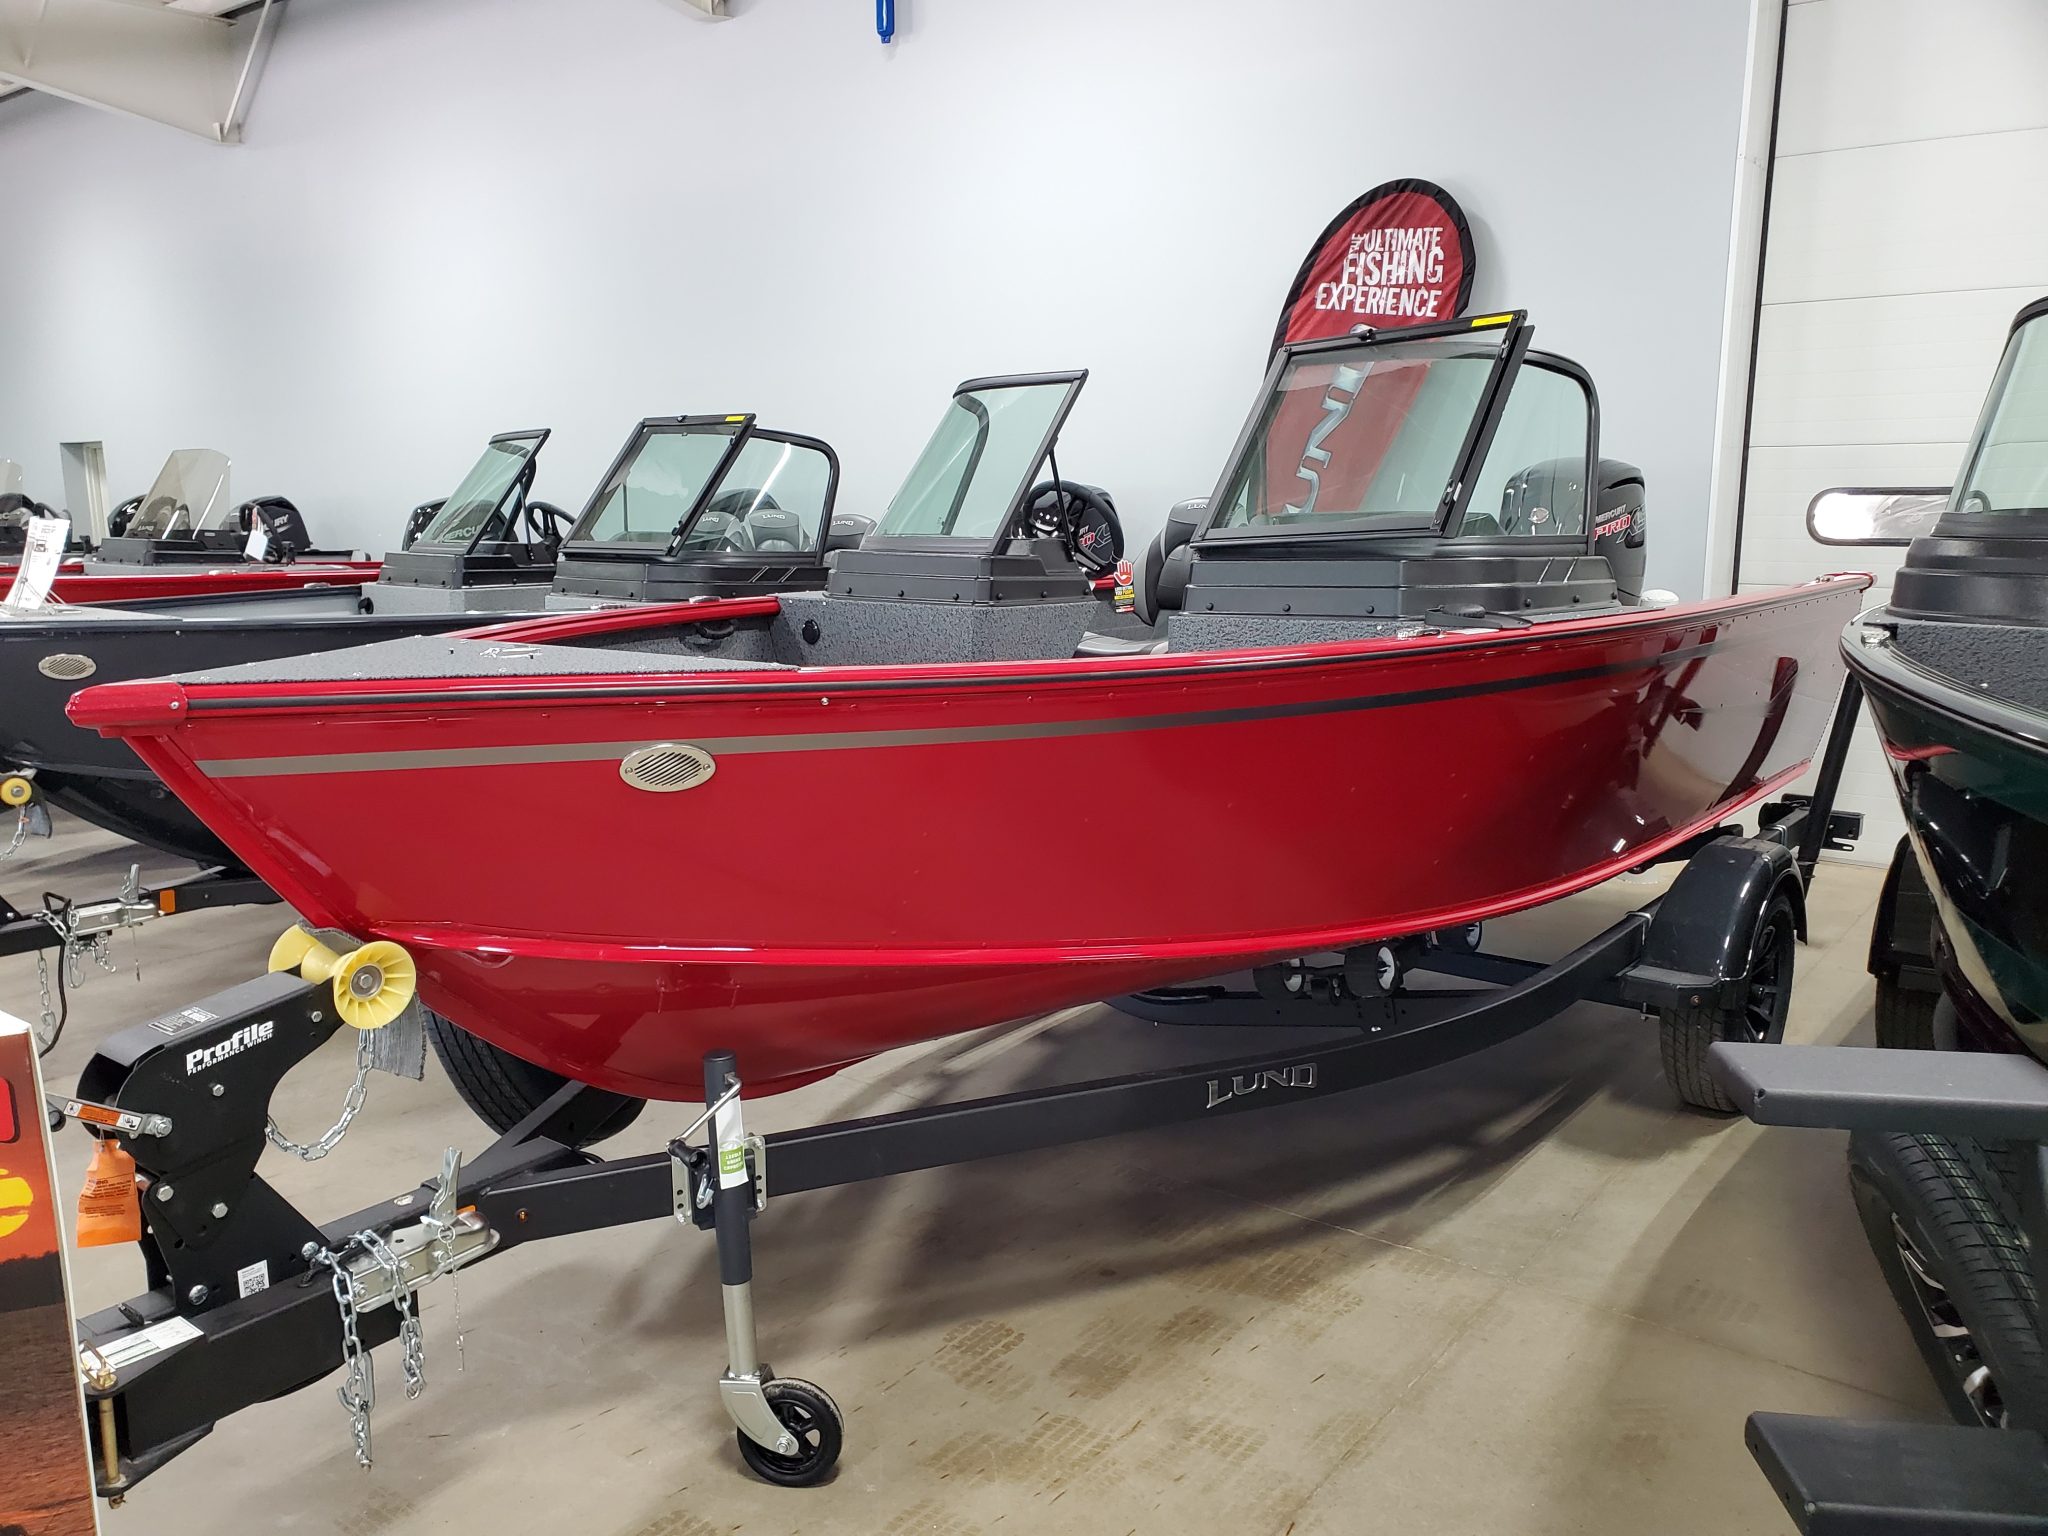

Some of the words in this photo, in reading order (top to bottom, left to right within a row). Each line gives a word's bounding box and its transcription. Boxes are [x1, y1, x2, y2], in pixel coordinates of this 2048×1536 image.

[1363, 226, 1444, 253] ULTIMATE
[1342, 248, 1445, 286] FISHING
[1314, 281, 1442, 318] EXPERIENCE
[1593, 514, 1631, 542] PRO
[186, 1020, 275, 1071] Profile
[187, 1043, 245, 1077] PERFORMANCE
[246, 1031, 274, 1049] WINCH
[1206, 1062, 1318, 1109] LUND
